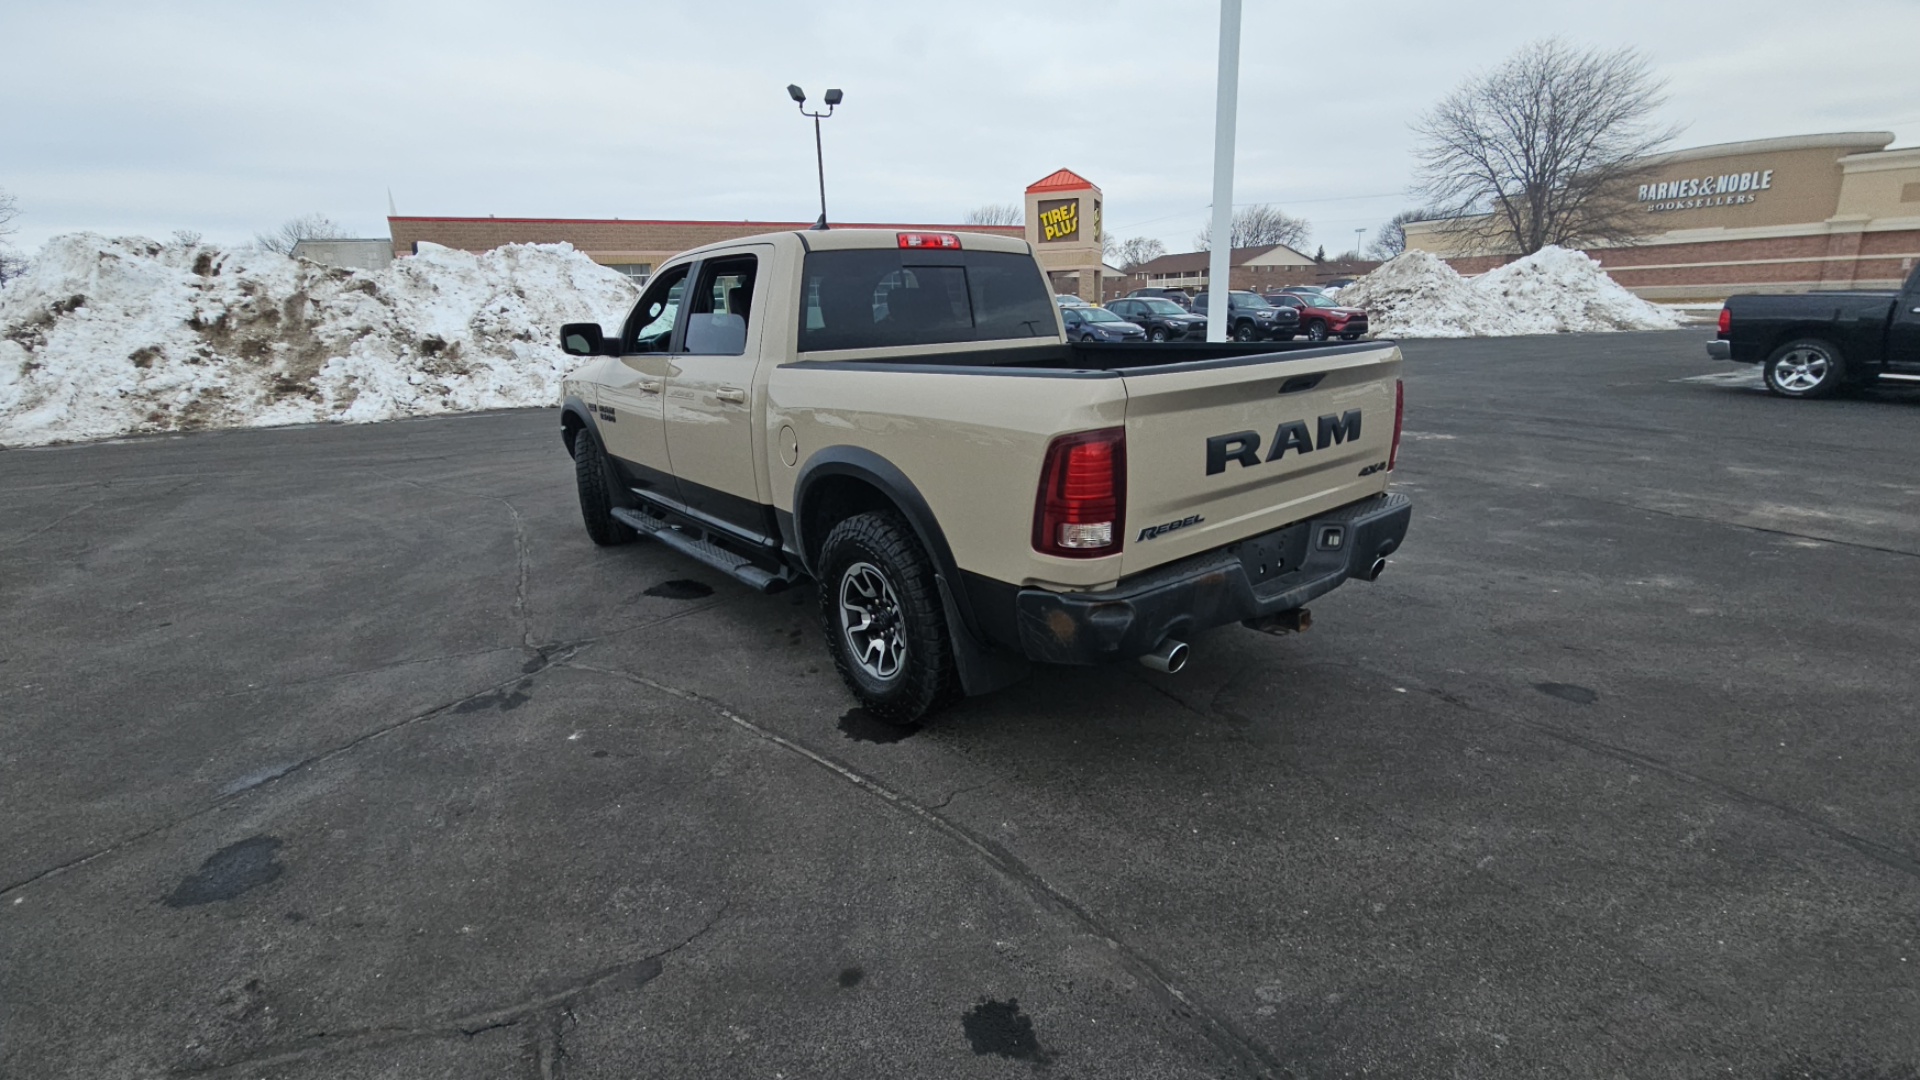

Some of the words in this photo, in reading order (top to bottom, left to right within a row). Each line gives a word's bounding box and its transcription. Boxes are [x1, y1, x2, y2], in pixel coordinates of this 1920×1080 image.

[1040, 202, 1076, 226] TIRES
[1647, 194, 1756, 212] BOOKSELLERS
[1045, 217, 1078, 240] PLUS
[1206, 407, 1362, 476] RAM
[1135, 514, 1205, 543] REBEL
